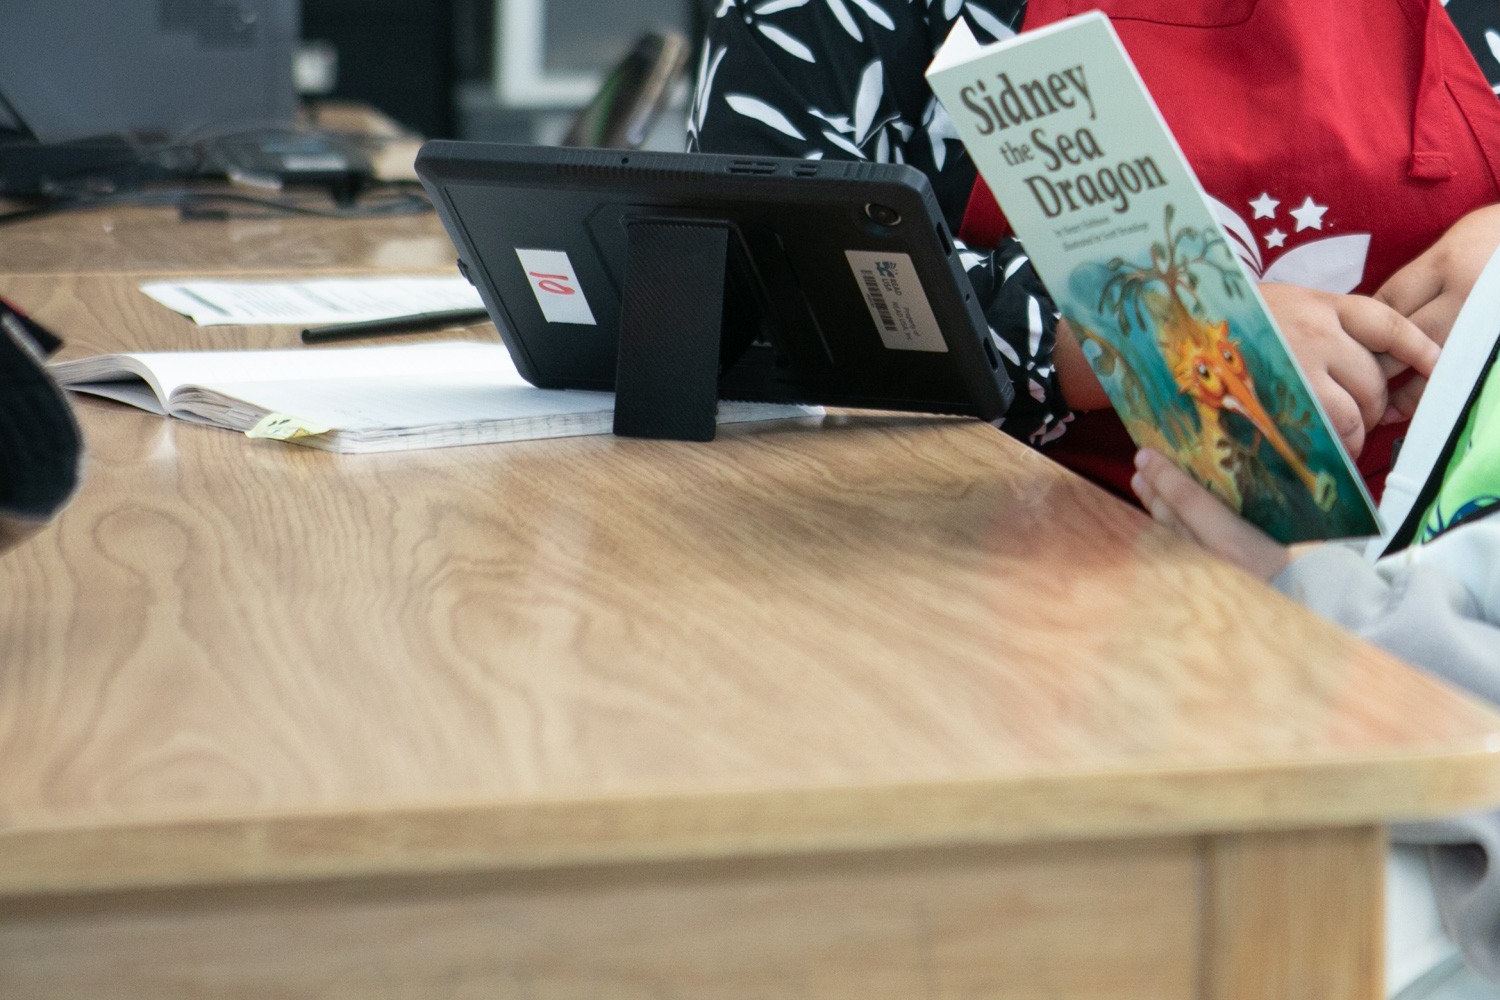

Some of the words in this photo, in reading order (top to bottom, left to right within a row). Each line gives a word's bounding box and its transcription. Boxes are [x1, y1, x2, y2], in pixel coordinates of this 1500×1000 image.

[959, 64, 1096, 135] Sidney
[999, 141, 1035, 167] the
[1030, 127, 1105, 172] Sea
[1023, 154, 1168, 219] Dragon
